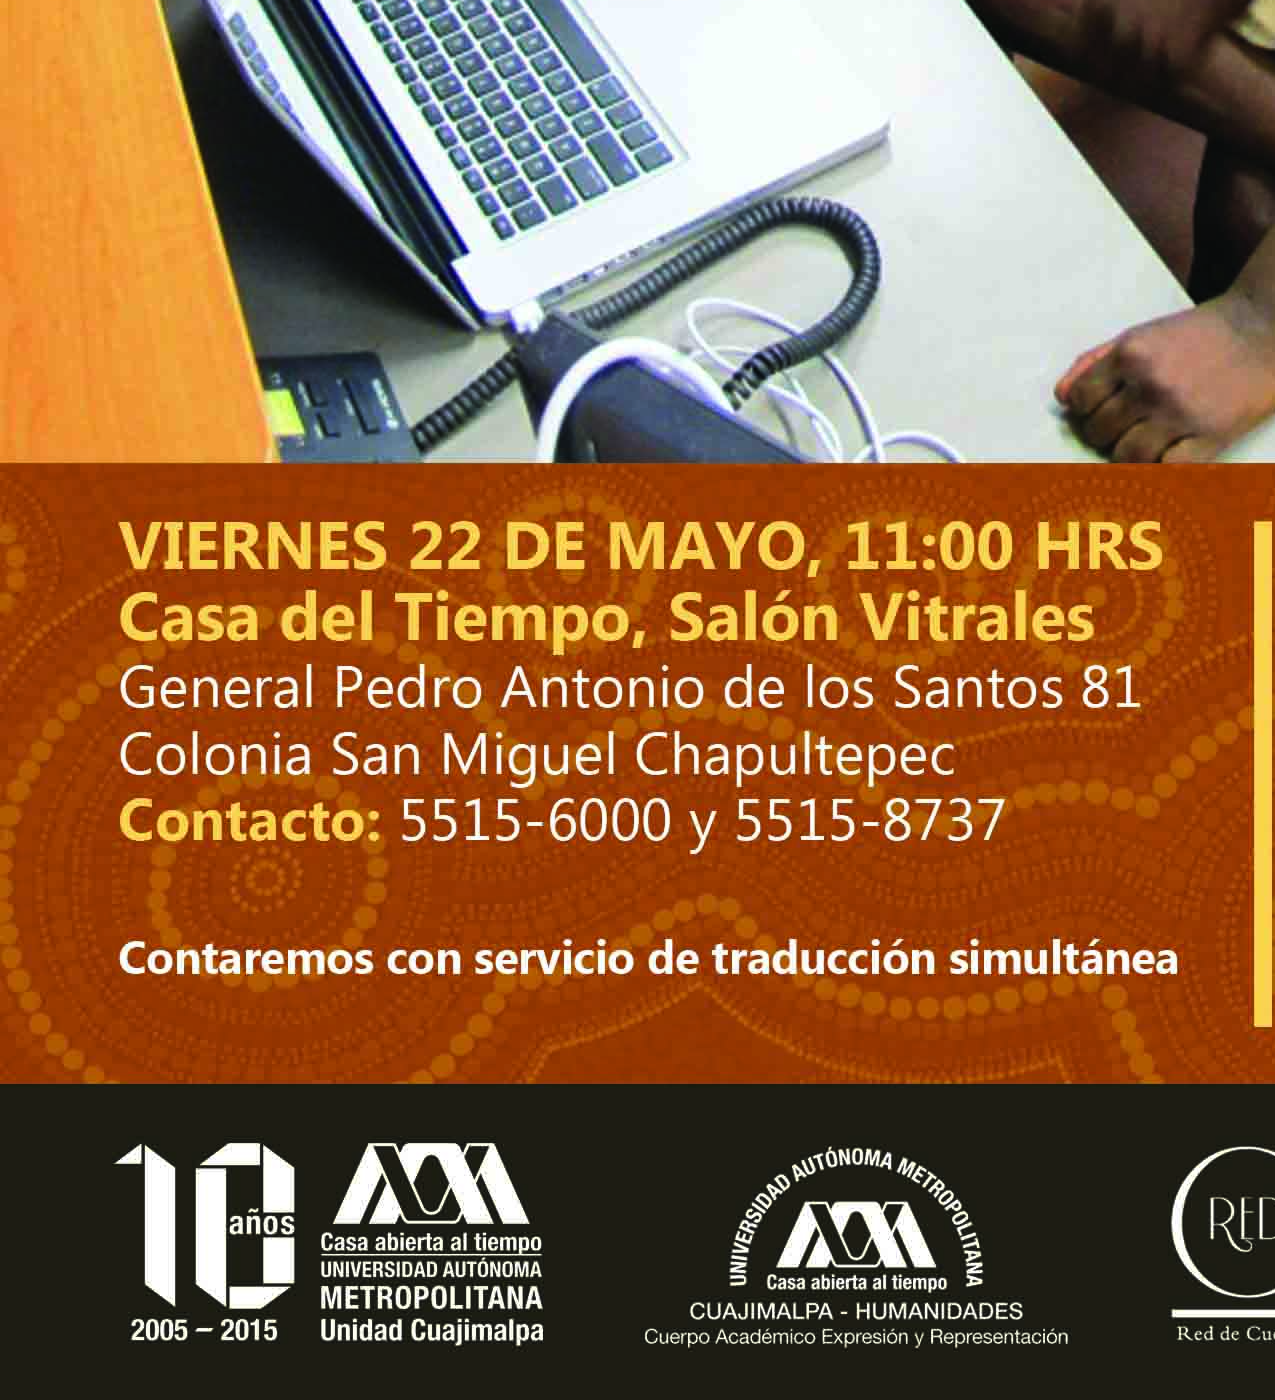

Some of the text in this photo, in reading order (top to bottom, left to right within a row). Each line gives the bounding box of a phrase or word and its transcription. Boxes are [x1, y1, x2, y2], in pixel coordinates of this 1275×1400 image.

[118, 519, 1164, 579] VIERNES 22 DE MAYO, 11:00 HRS
[119, 588, 1095, 657] Casa del Tiempo, Salón Vitrales
[119, 662, 1142, 710] General Pedro Antonio de los Santos 81
[119, 729, 955, 790] Colonia San Miguel Chapultepec
[118, 796, 1006, 856] Contacto: 5515-6000 y 5515-8737
[118, 937, 1179, 976] Contaremos con servicio de traducción simultánea
[229, 1207, 295, 1236] años
[729, 1146, 984, 1288] UNIVERSIDAD AUTÓNOMA METROPOLITANA
[320, 1231, 542, 1257] Casa abierta al tiempo
[320, 1256, 543, 1278] UNIVERSIDAD AUTÓNOMA
[320, 1284, 544, 1310] METROPOLITANA
[766, 1273, 948, 1294] Casa abierta al tiempo
[689, 1301, 1024, 1321] CUAJIMALPA HUMANIDADES
[130, 1318, 278, 1342] 2005 2015
[320, 1317, 544, 1347] Unidad Cuajimalpa
[644, 1327, 1069, 1349] Cuerpo Académico Expresión y Representación
[1176, 1325, 1214, 1341] Red
[1220, 1325, 1240, 1341] de
